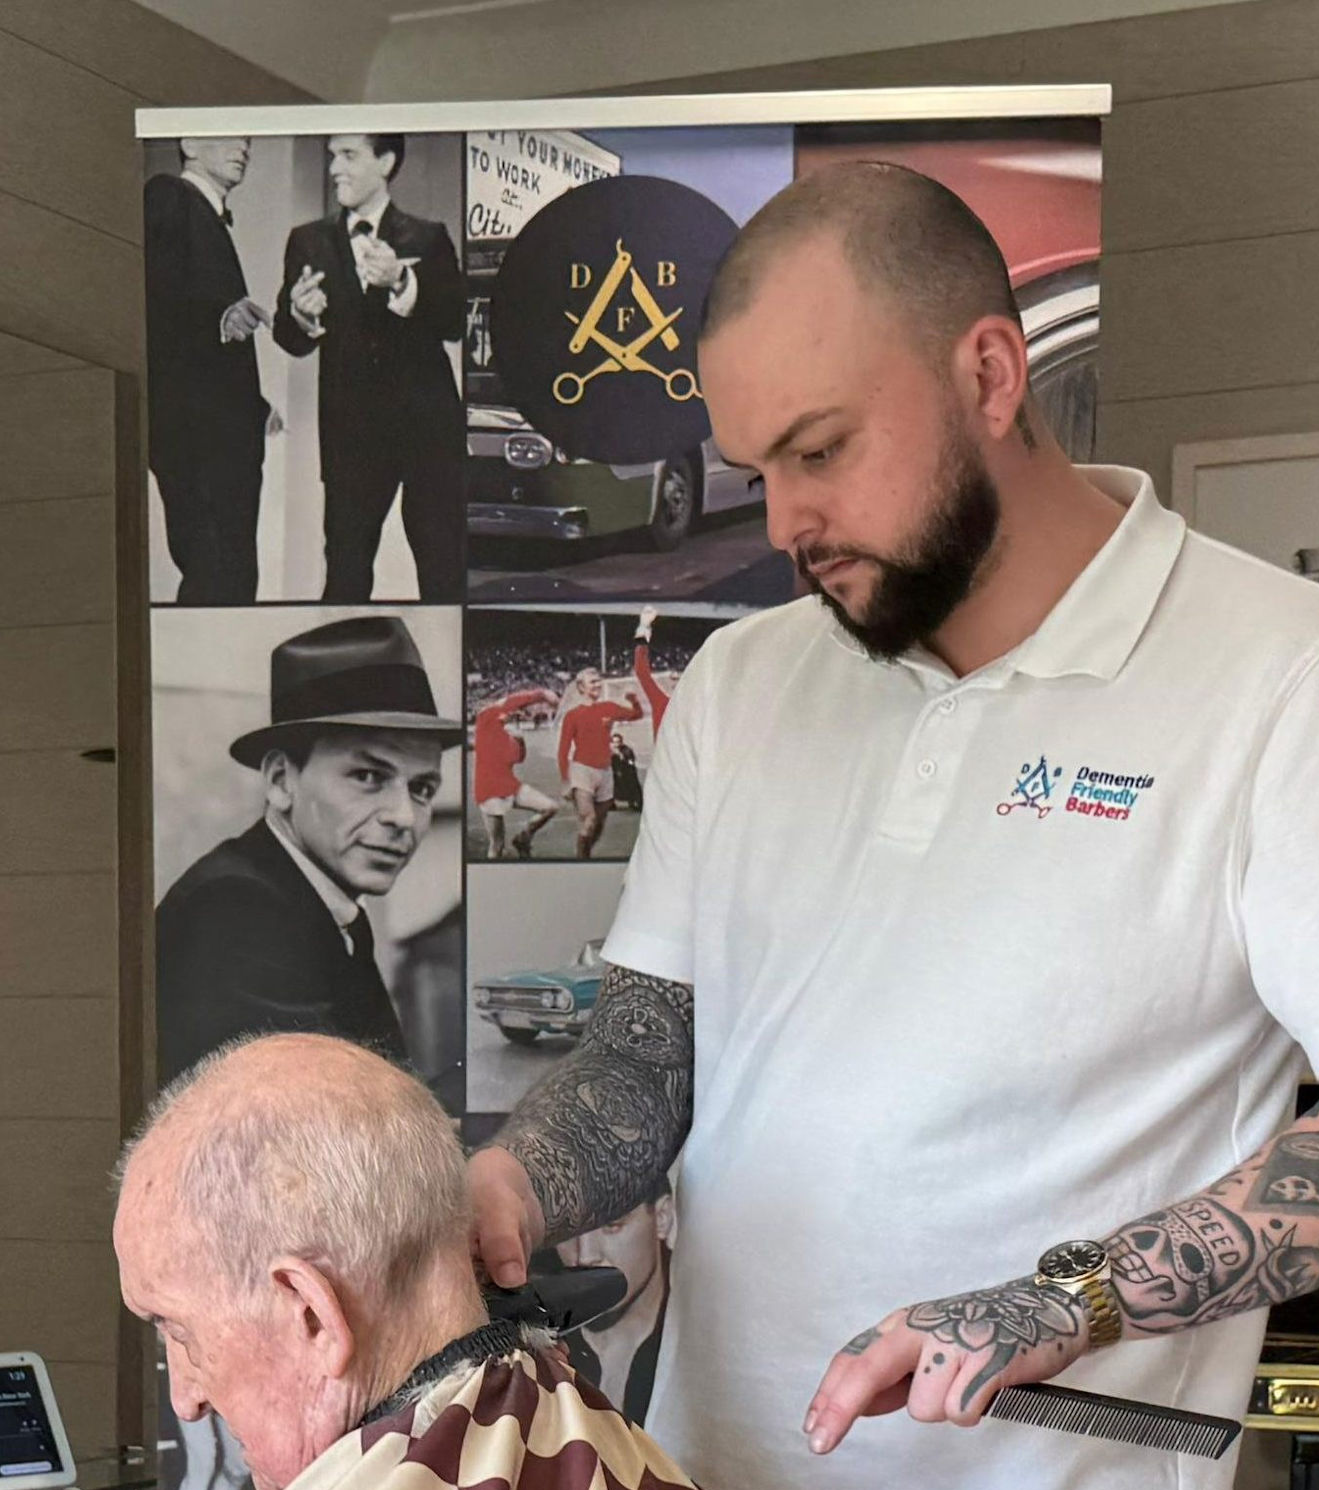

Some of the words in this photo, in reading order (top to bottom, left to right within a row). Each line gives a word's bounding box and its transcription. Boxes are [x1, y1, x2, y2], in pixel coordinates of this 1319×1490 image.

[517, 132, 559, 171] YOUR
[470, 145, 490, 172] TO
[495, 156, 541, 195] WORK
[570, 263, 592, 289] D
[657, 260, 677, 287] B
[616, 306, 635, 332] F
[1076, 766, 1155, 789] Dementia
[1070, 781, 1138, 807] Friendly
[1065, 797, 1132, 821] Barbers
[1177, 1201, 1241, 1266] SPEED
